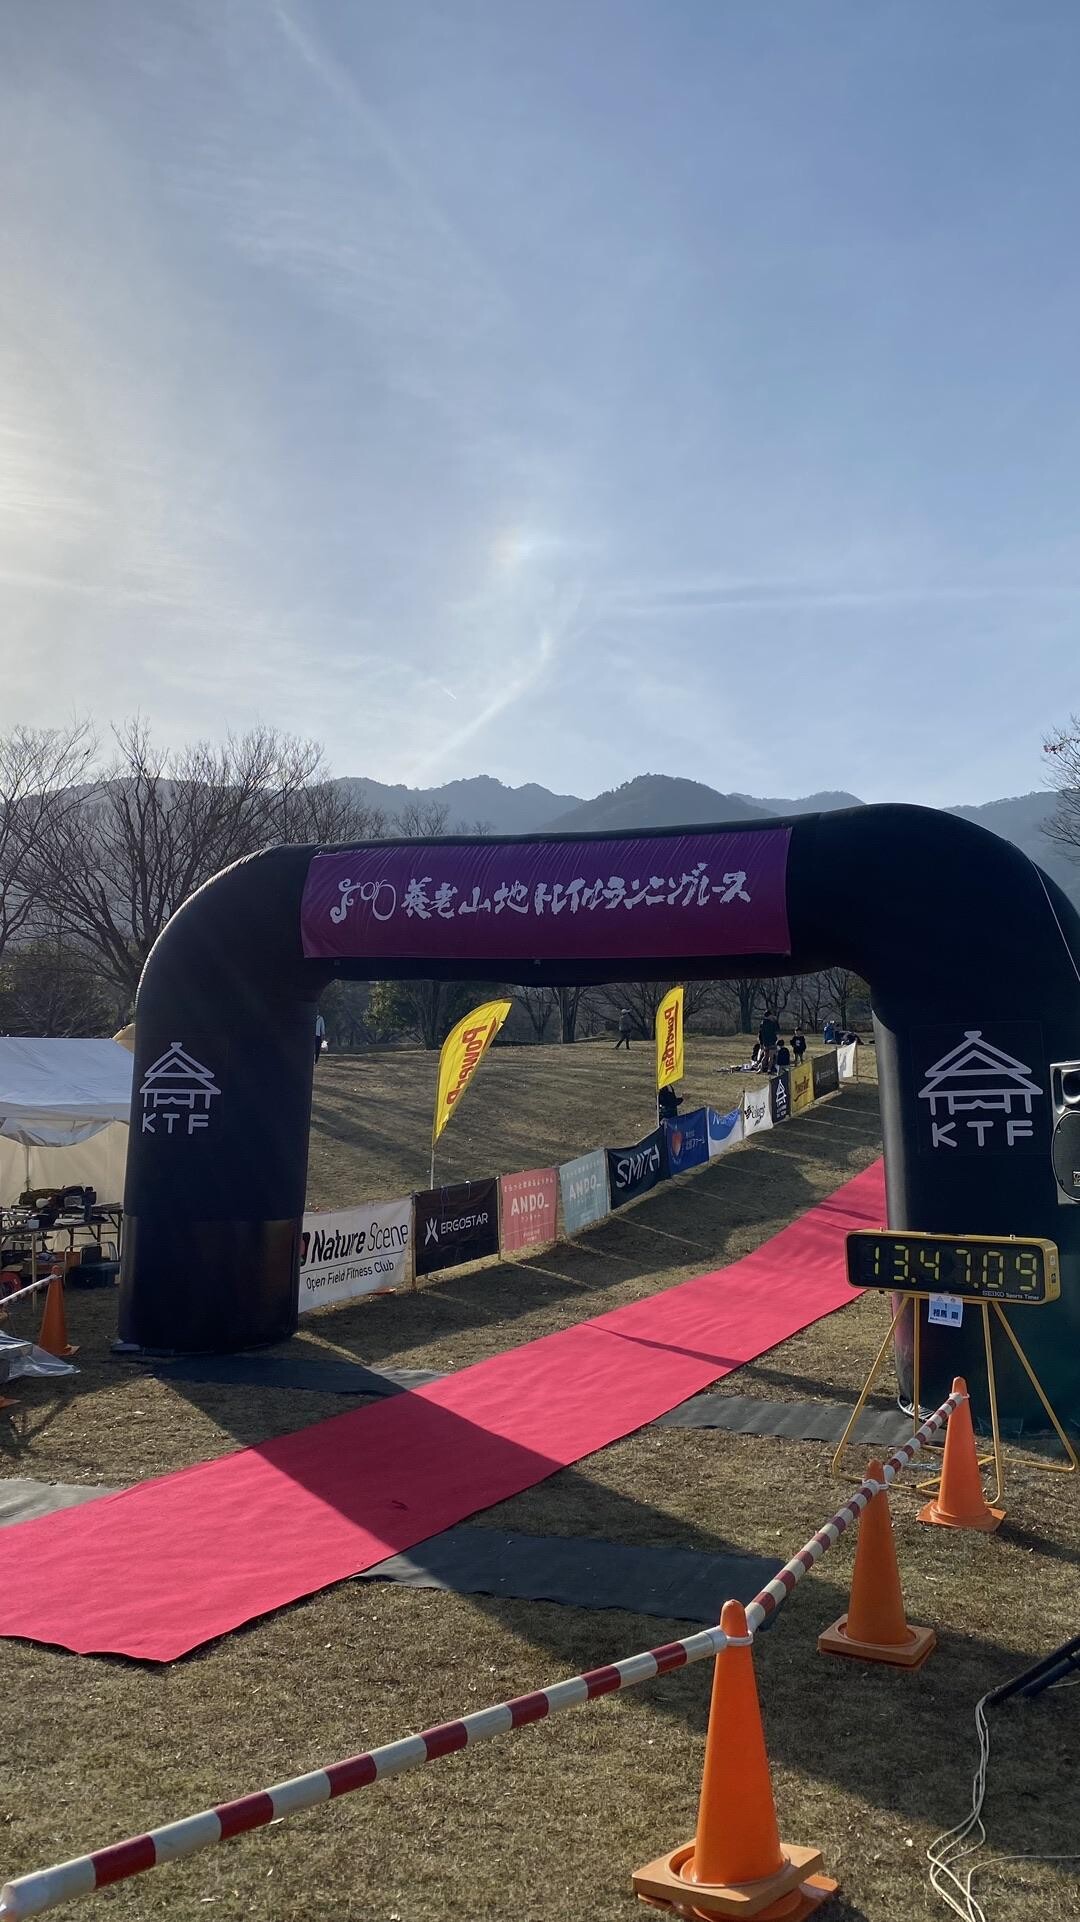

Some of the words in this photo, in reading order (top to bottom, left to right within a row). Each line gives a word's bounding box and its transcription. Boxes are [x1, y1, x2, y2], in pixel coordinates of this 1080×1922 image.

[141, 1112, 210, 1135] KTF
[931, 1120, 1034, 1148] KTF
[616, 1144, 660, 1188] SMITH
[440, 1212, 489, 1235] ERGOSTAR
[310, 1229, 366, 1264] Nature
[367, 1222, 409, 1252] Scene
[306, 1277, 326, 1292] Open
[327, 1271, 345, 1285] Field
[346, 1265, 373, 1280] Fitness
[373, 1259, 394, 1273] Club
[982, 1290, 1005, 1298] SEIKO
